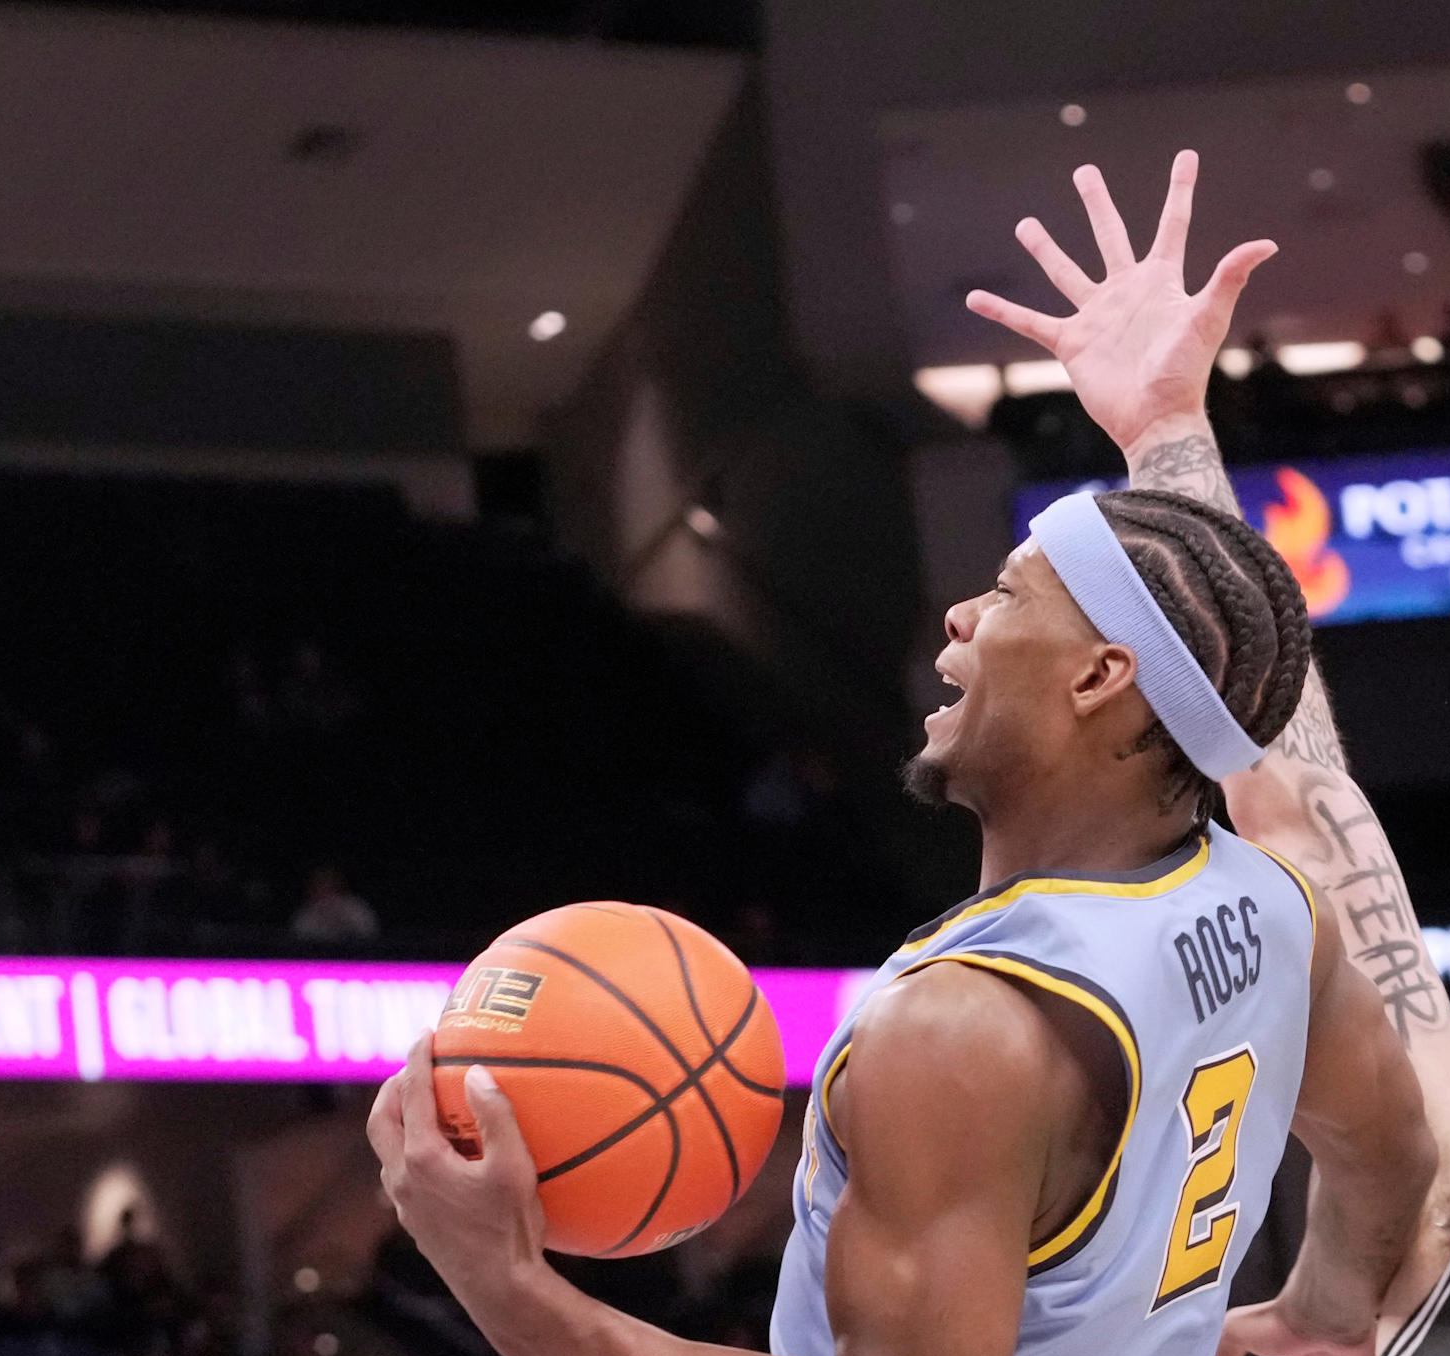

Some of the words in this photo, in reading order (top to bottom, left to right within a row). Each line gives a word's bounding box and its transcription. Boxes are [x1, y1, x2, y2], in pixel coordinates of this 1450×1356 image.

[107, 977, 311, 1062] GLOBAL
[1173, 895, 1262, 1024] ROSS
[1145, 1041, 1260, 1320] 2
